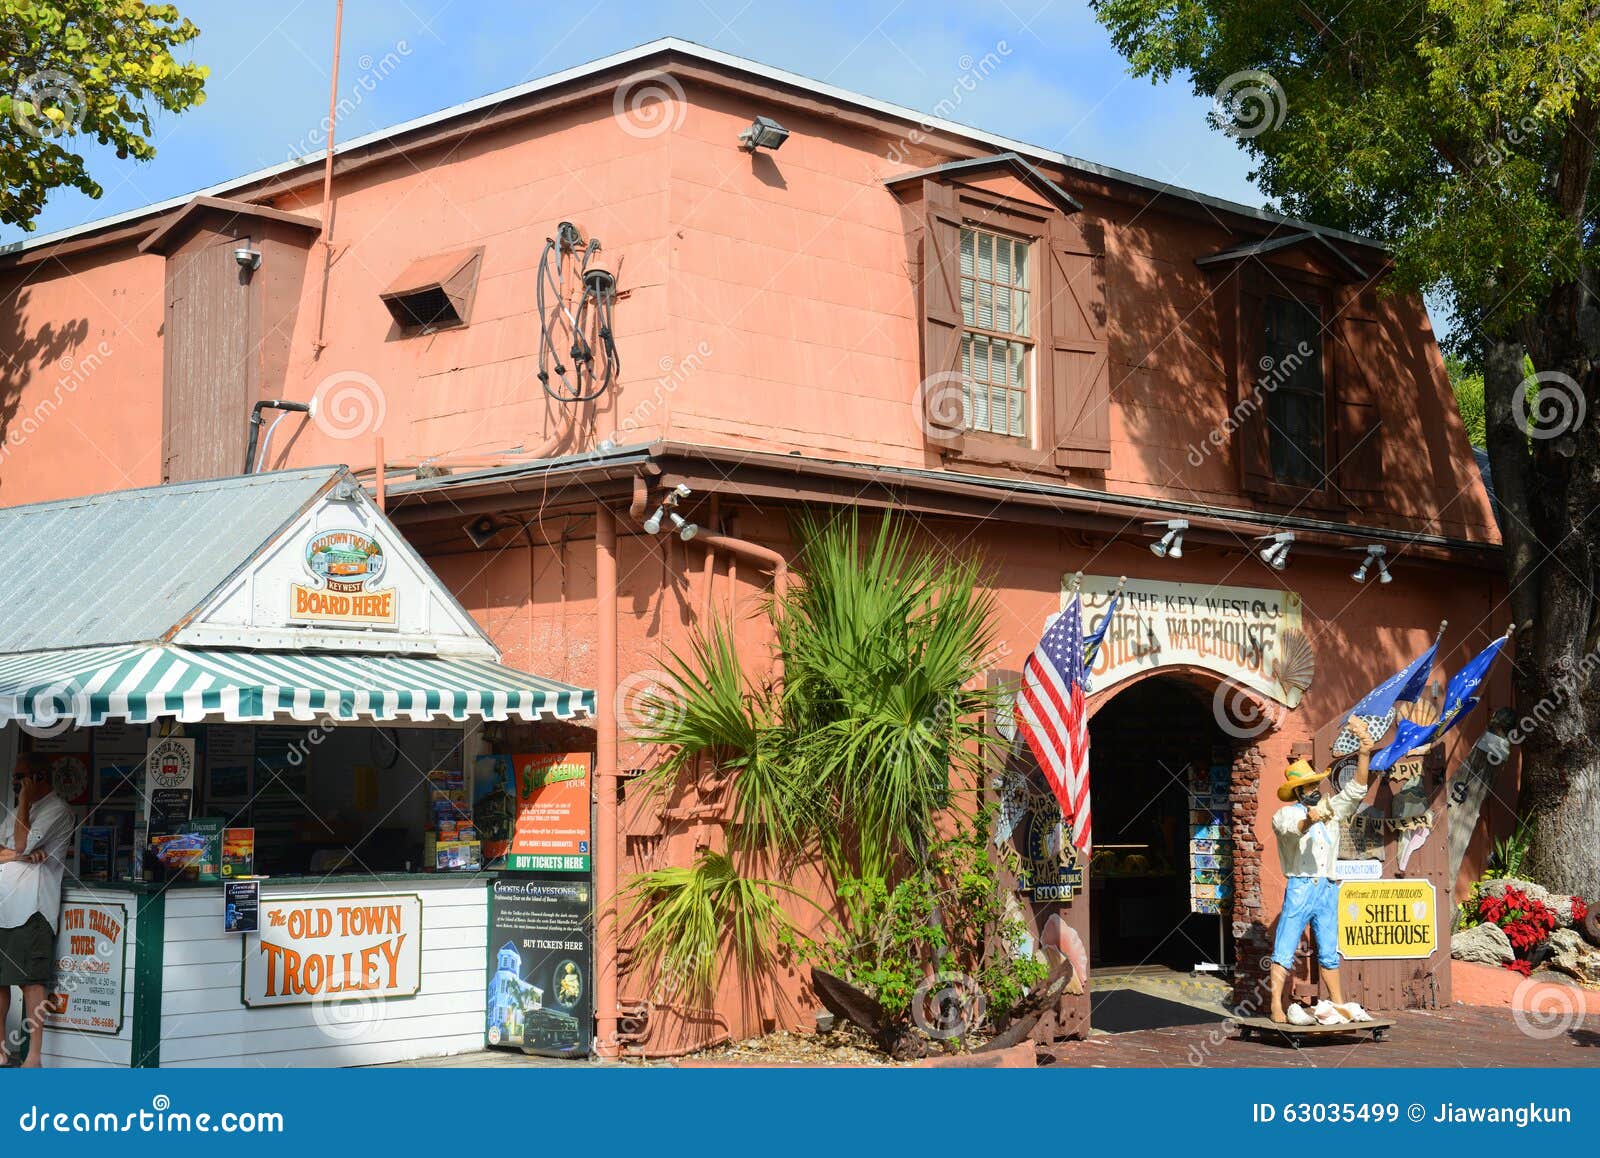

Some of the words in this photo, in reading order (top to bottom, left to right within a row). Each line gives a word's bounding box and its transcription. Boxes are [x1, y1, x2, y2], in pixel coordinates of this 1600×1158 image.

[312, 540, 326, 554] OLD
[326, 533, 348, 548] TOWN
[328, 582, 341, 592] KEY
[342, 582, 361, 592] WEST
[296, 587, 350, 616] BOARD
[352, 593, 392, 618] HERE
[1127, 591, 1164, 612] THE
[1165, 595, 1200, 615] KEY
[1205, 597, 1250, 618] WEST
[1089, 613, 1162, 676] SHELL
[1165, 616, 1278, 681] WAREHOUSE
[155, 773, 185, 788] TOURS
[565, 780, 586, 789] TOUR
[1386, 815, 1429, 830] YEAR
[516, 856, 531, 868] BUY
[532, 857, 563, 869] TICKETS
[564, 857, 584, 869] HERE
[494, 880, 520, 894] GHOSTS
[526, 881, 577, 896] GRAVESTONES
[1036, 885, 1071, 899] STORE
[1371, 890, 1379, 900] TO
[1391, 888, 1423, 899] FABULOUS
[268, 908, 287, 927] The
[287, 908, 333, 940] OLD
[337, 905, 402, 937] TOWN
[1365, 904, 1411, 924] SHELL
[64, 908, 85, 931] TOWN
[89, 909, 121, 944] TROLLEY
[1345, 924, 1430, 946] WAREHOUSE
[70, 935, 96, 956] TOURS
[523, 939, 536, 949] BUY
[537, 940, 563, 950] TICKETS
[565, 942, 584, 951] HERE
[260, 933, 407, 998] TROLLEY
